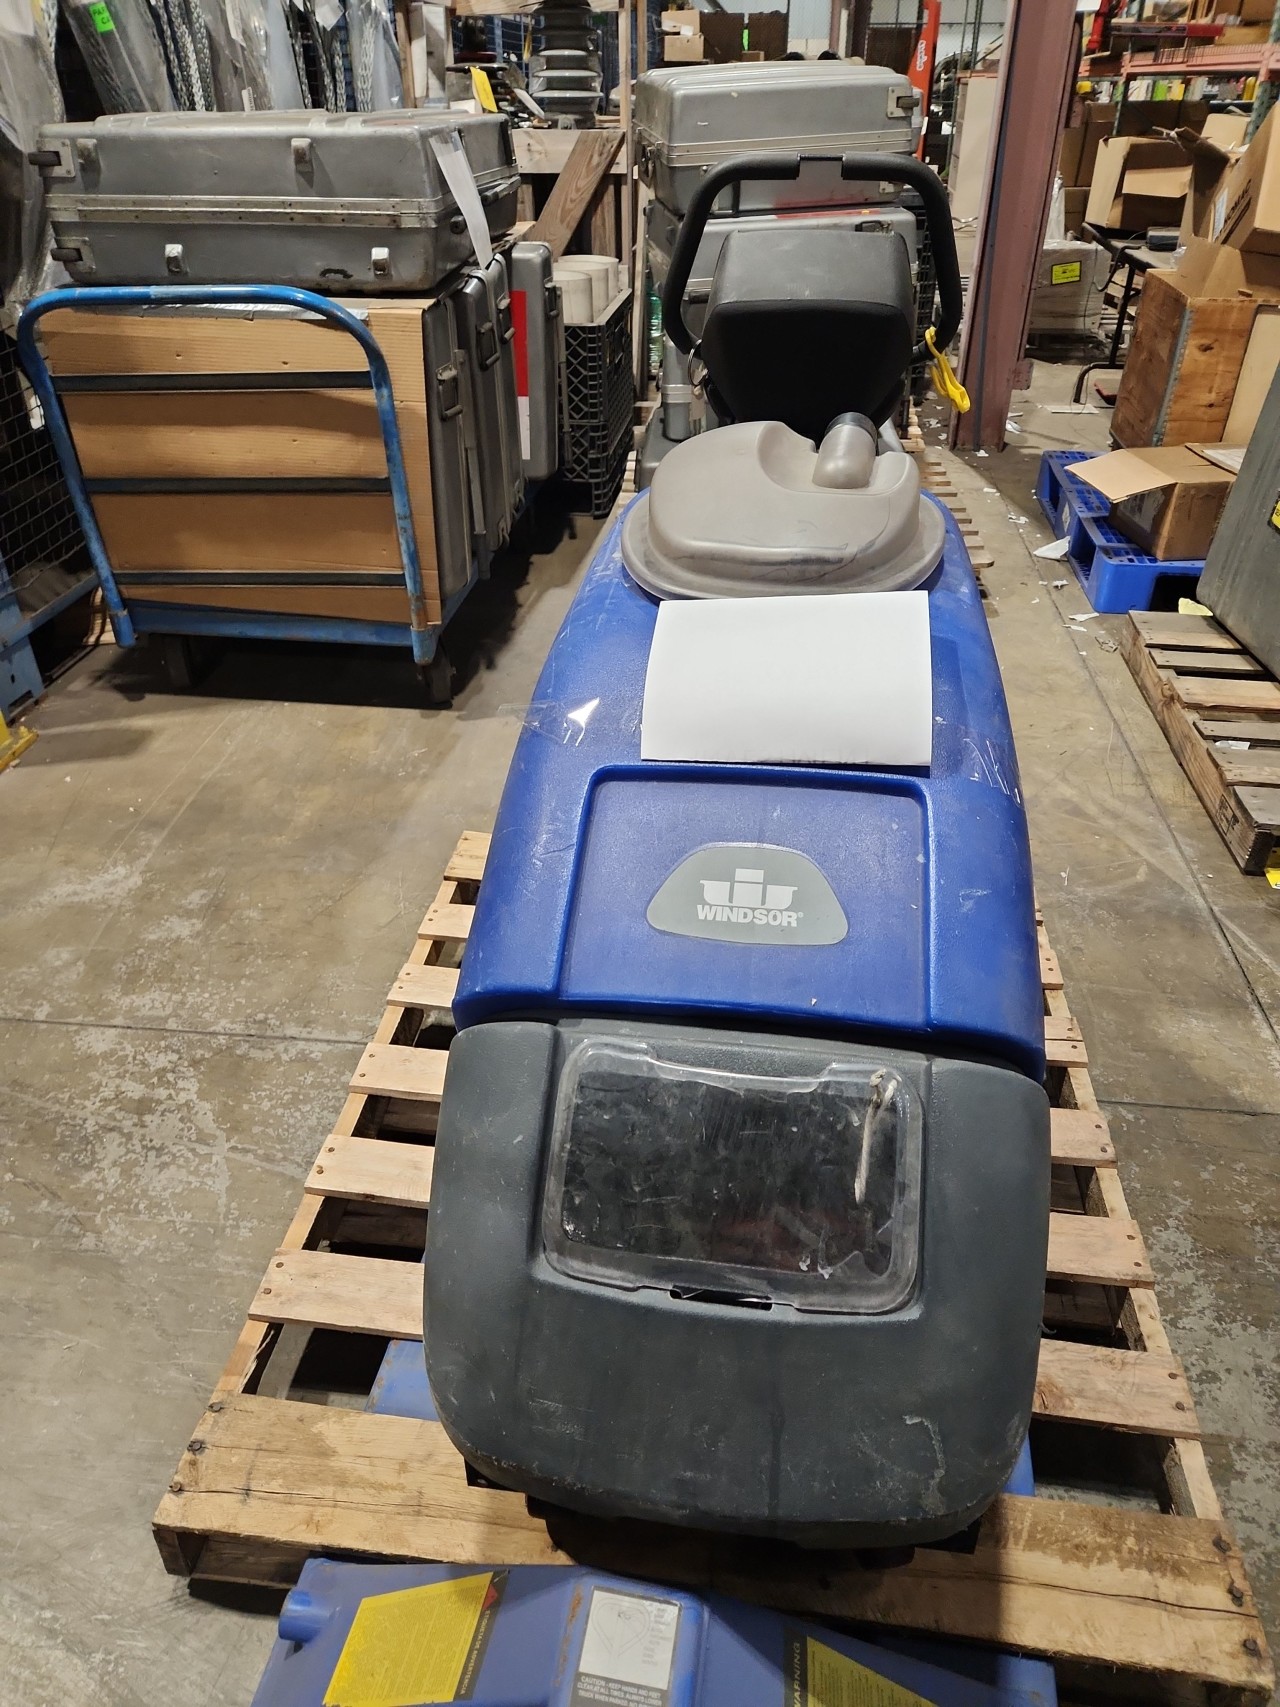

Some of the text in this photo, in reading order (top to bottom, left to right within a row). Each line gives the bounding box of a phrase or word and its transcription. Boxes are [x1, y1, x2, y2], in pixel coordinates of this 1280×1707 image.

[696, 904, 799, 928] WINDSOR
[474, 1640, 482, 1649] DE
[460, 1650, 478, 1696] ADVERTENCIA
[577, 1681, 593, 1691] CLEAR
[580, 1675, 606, 1687] CAUTION
[609, 1682, 621, 1690] KEEP
[638, 1688, 648, 1697] AND
